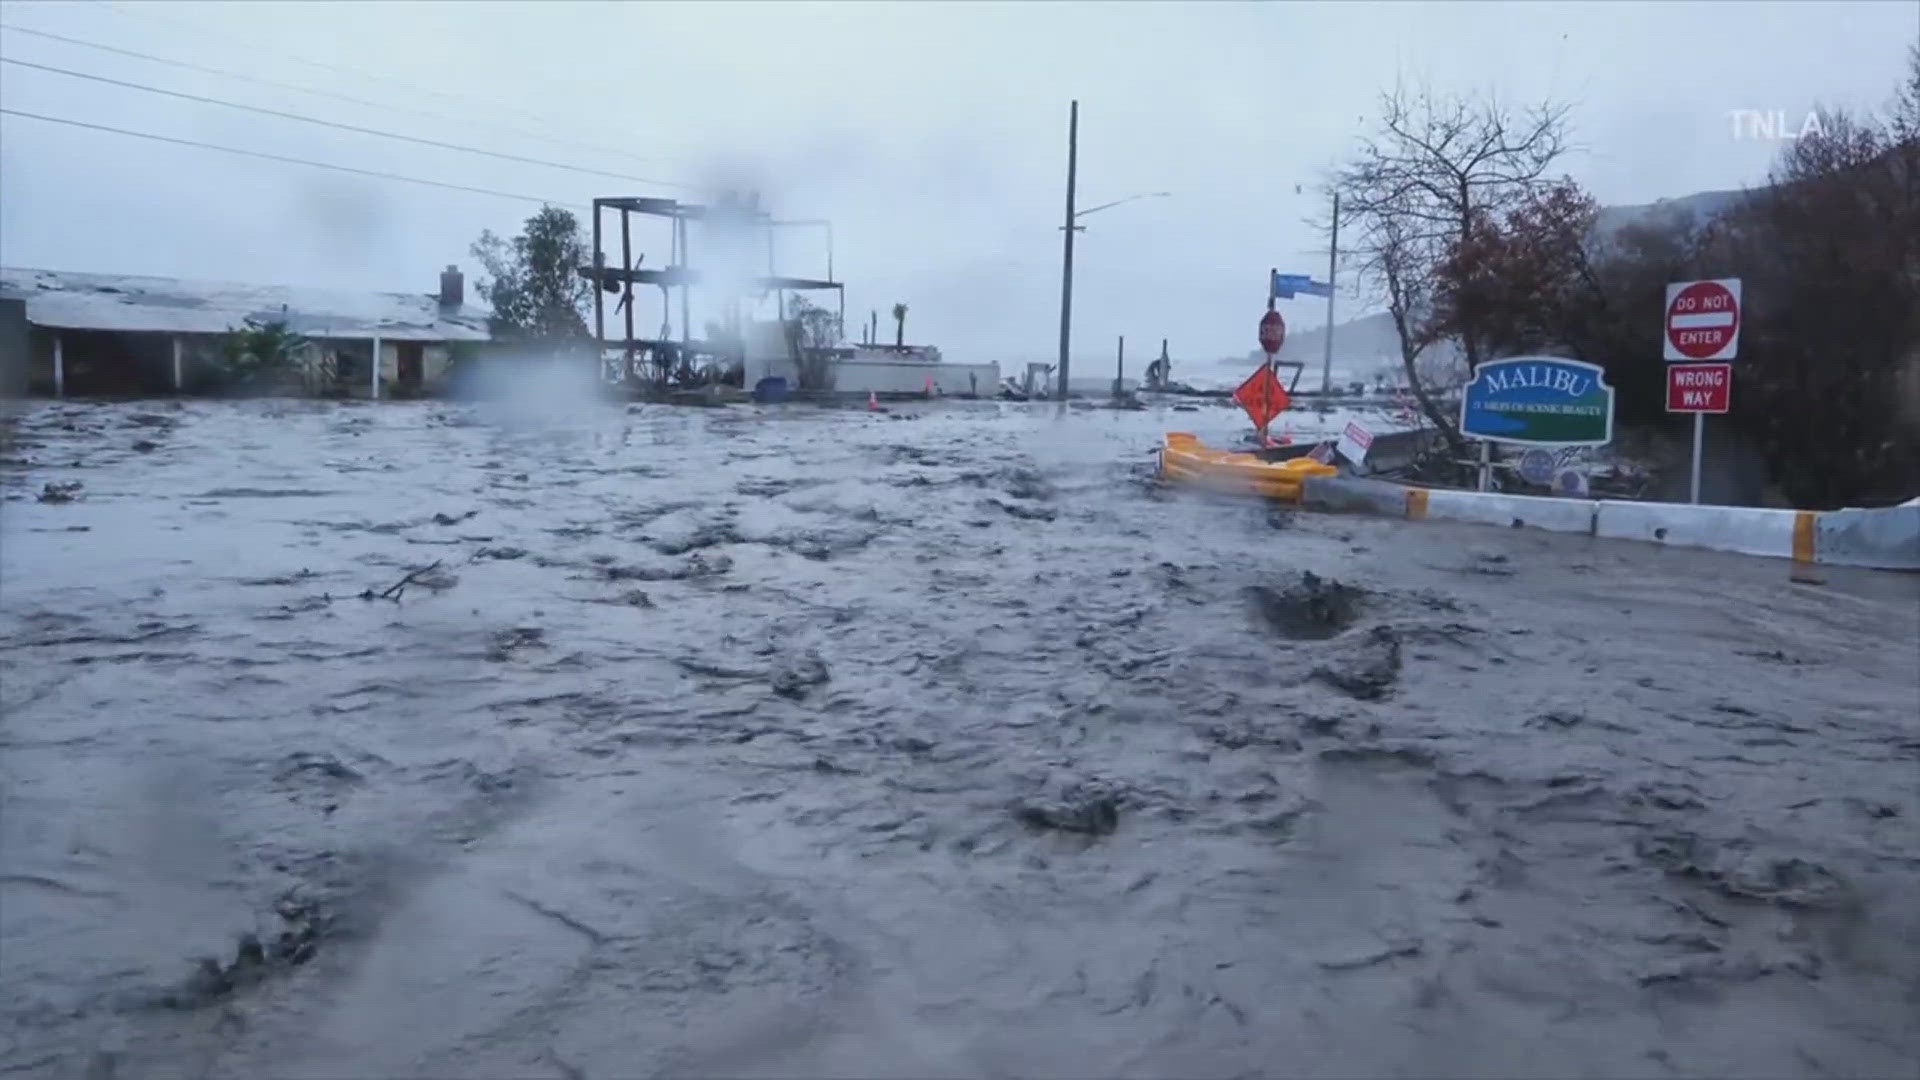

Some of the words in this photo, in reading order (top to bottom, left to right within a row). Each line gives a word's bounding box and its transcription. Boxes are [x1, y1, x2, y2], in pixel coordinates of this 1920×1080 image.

[1677, 297, 1695, 311] DO
[1703, 294, 1729, 309] NOT
[1679, 331, 1722, 345] ENTER
[1486, 366, 1591, 397] MALIBU
[1675, 371, 1723, 387] WRONG
[1682, 391, 1713, 406] WAY
[1562, 404, 1600, 416] BEAUTY
